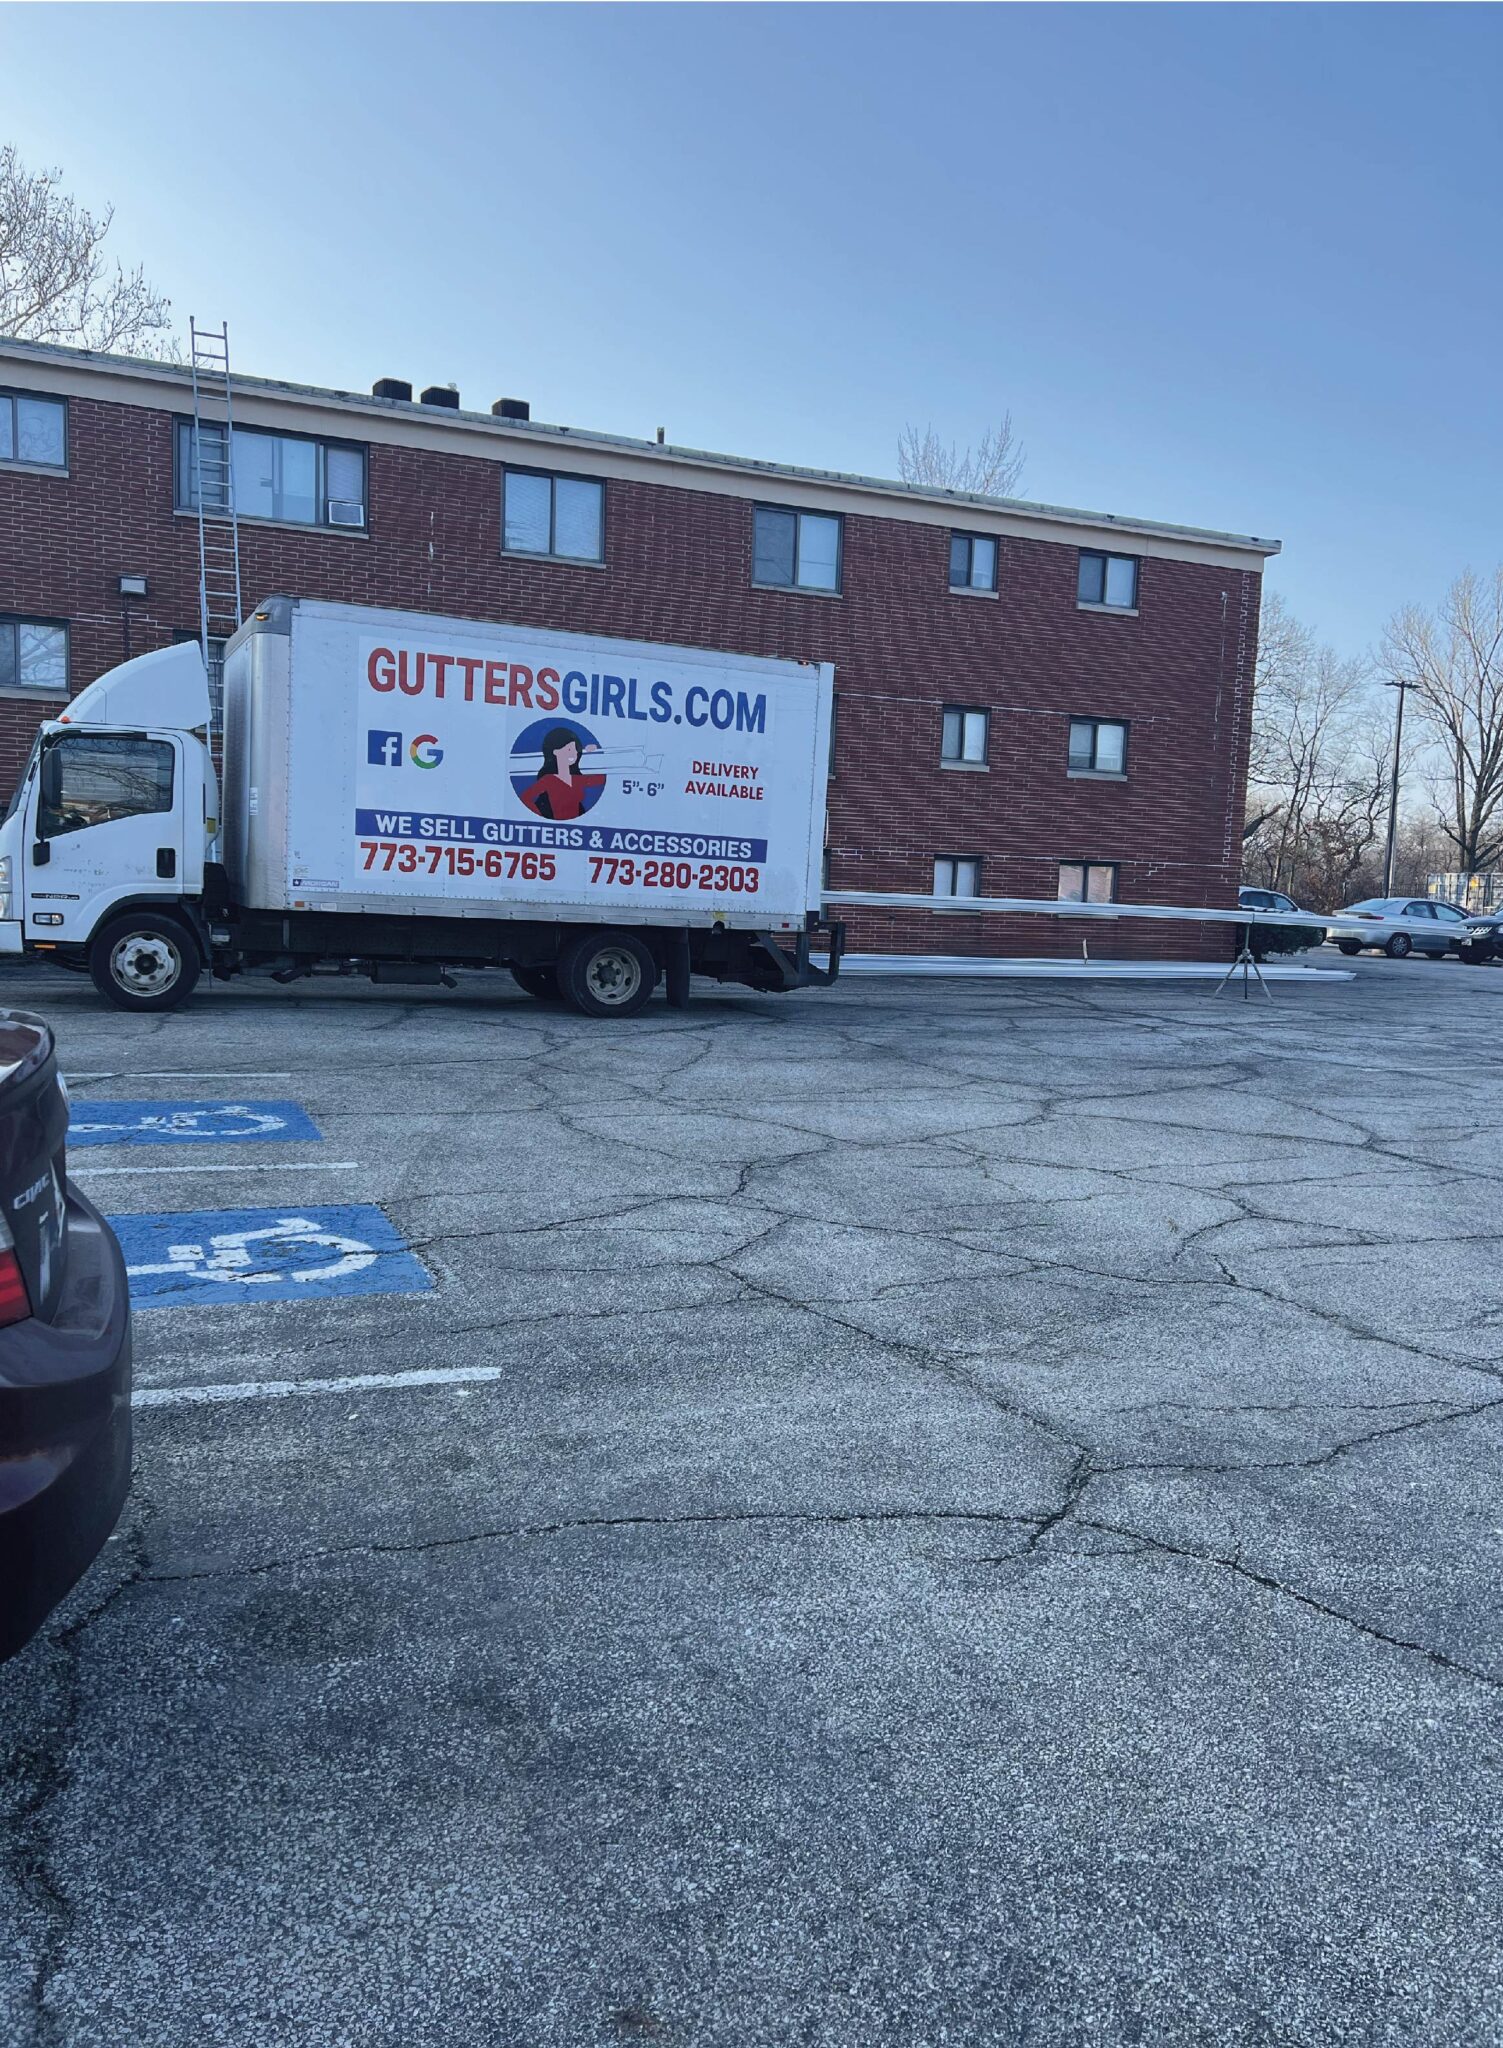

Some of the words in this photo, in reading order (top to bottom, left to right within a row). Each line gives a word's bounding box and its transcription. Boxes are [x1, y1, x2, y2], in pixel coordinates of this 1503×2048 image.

[367, 647, 767, 733] GUTTERSGIRLS.COM
[692, 760, 759, 780] DELIVERY
[684, 780, 764, 801] AVAILABLE
[375, 814, 412, 834] WE
[420, 817, 475, 839] SELL
[482, 823, 583, 847] GUTTERS
[589, 830, 603, 848] &
[610, 832, 752, 859] ACCESSORIES
[360, 841, 556, 881] 773-715-6765
[588, 856, 759, 893] 773-280-2303
